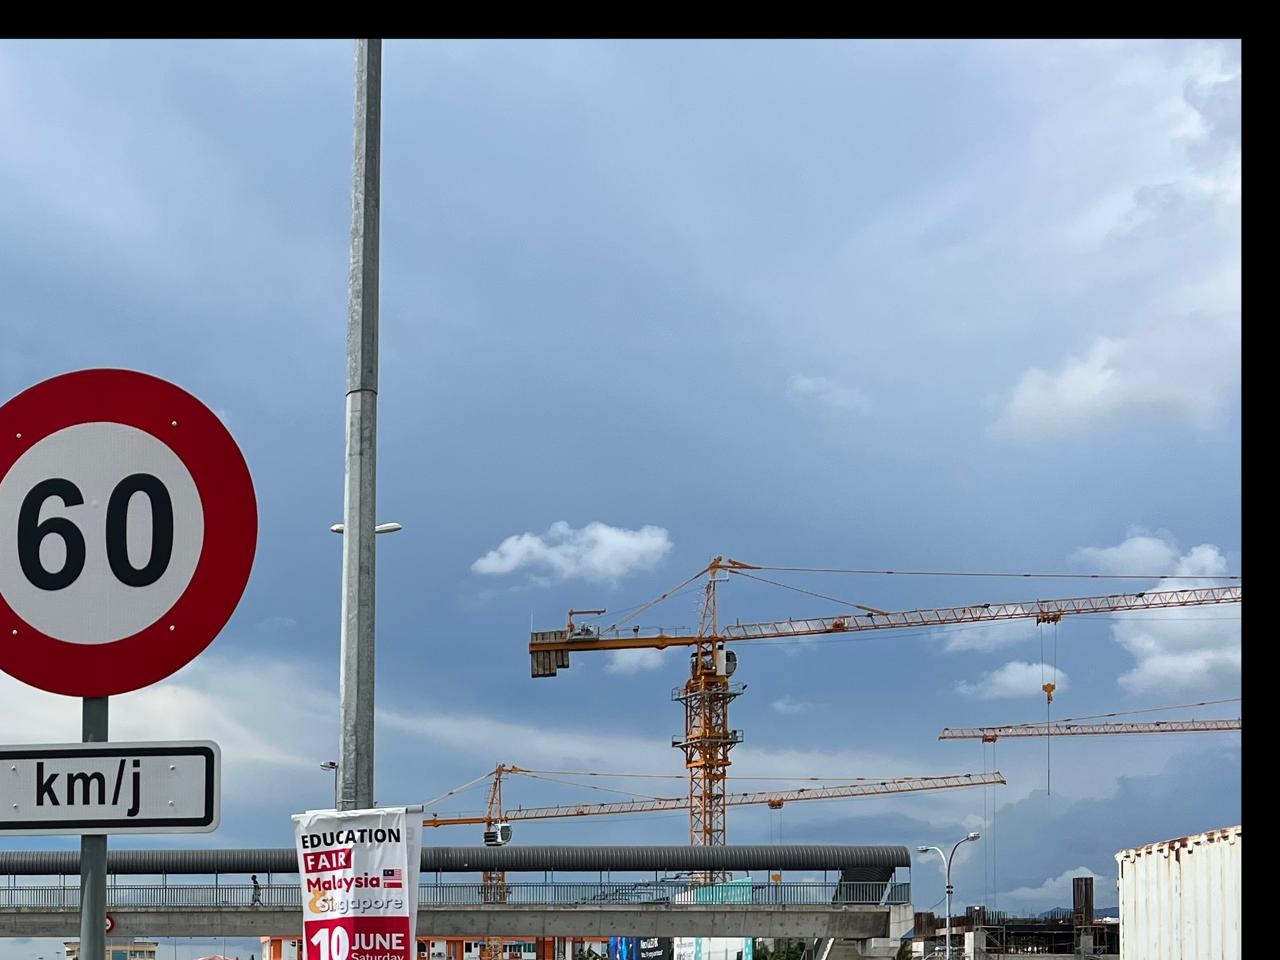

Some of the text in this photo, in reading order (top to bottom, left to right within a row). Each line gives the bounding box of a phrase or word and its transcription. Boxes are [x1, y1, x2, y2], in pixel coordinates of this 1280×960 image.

[17, 473, 174, 591] 60
[36, 759, 141, 817] km/j
[301, 828, 400, 849] EDUCATION
[306, 851, 347, 871] FAIR
[306, 872, 381, 893] Malaysia
[351, 933, 404, 950] JUNE
